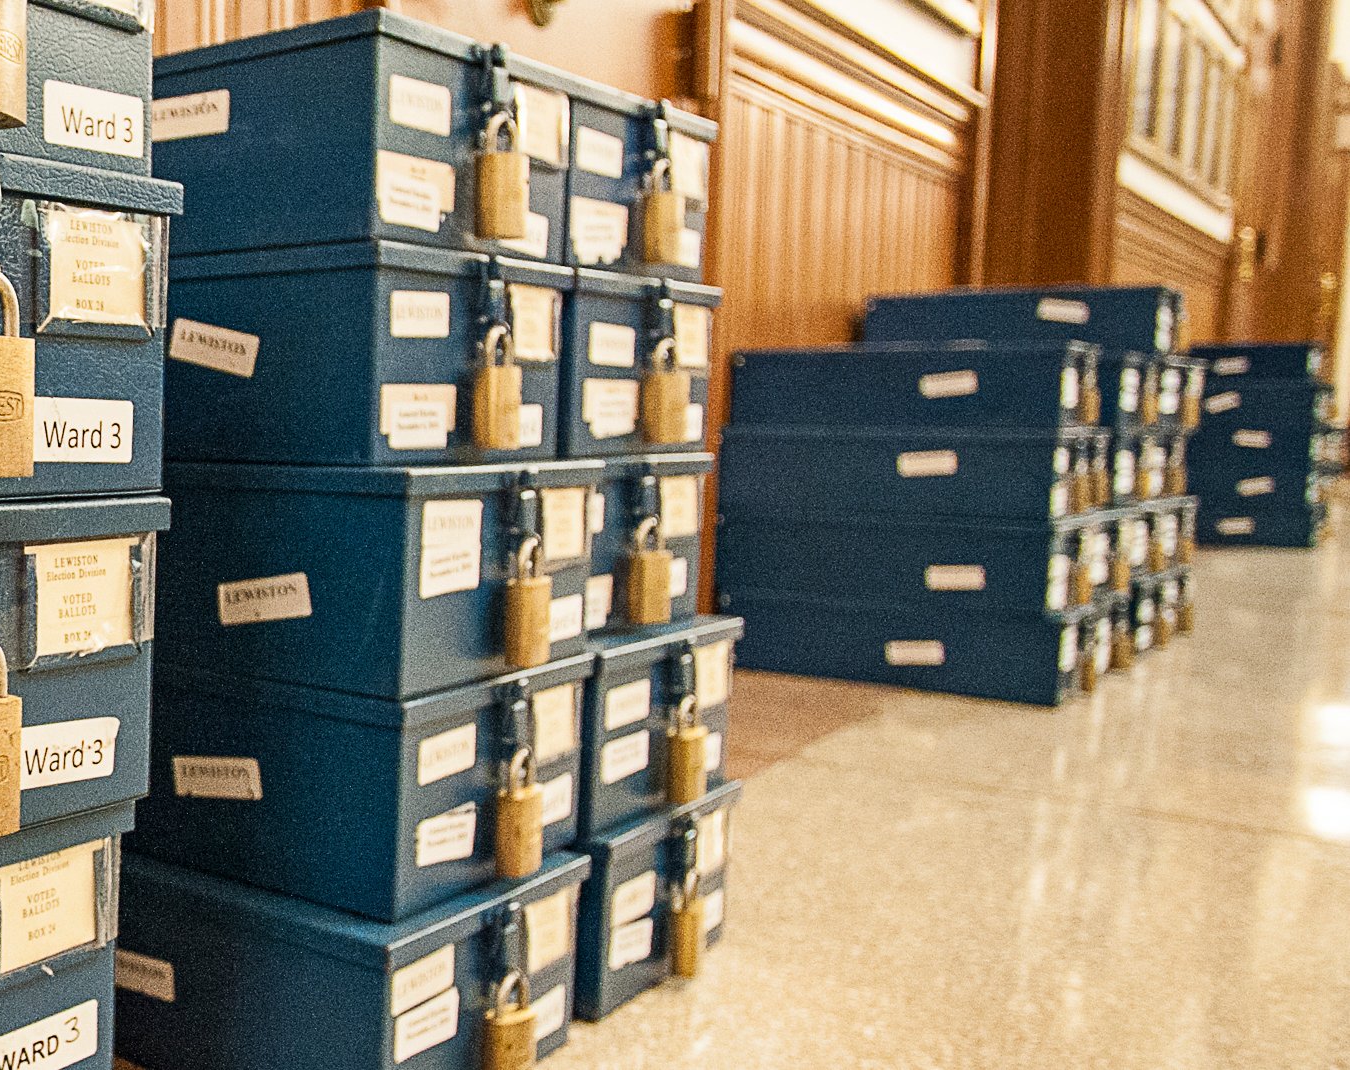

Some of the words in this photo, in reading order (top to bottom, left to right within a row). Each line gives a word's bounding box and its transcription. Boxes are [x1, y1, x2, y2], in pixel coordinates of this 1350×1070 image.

[61, 105, 116, 140] Ward
[123, 117, 133, 143] 3
[44, 421, 102, 448] Ward
[110, 422, 121, 449] 3
[54, 555, 99, 569] LEWISTON
[63, 593, 92, 604] VOTED
[58, 605, 97, 619] BALLOTS
[64, 632, 81, 643] BOX
[25, 740, 84, 775] Ward
[92, 739, 103, 765] 3
[27, 888, 56, 904] VOTED
[64, 1017, 81, 1044] 3
